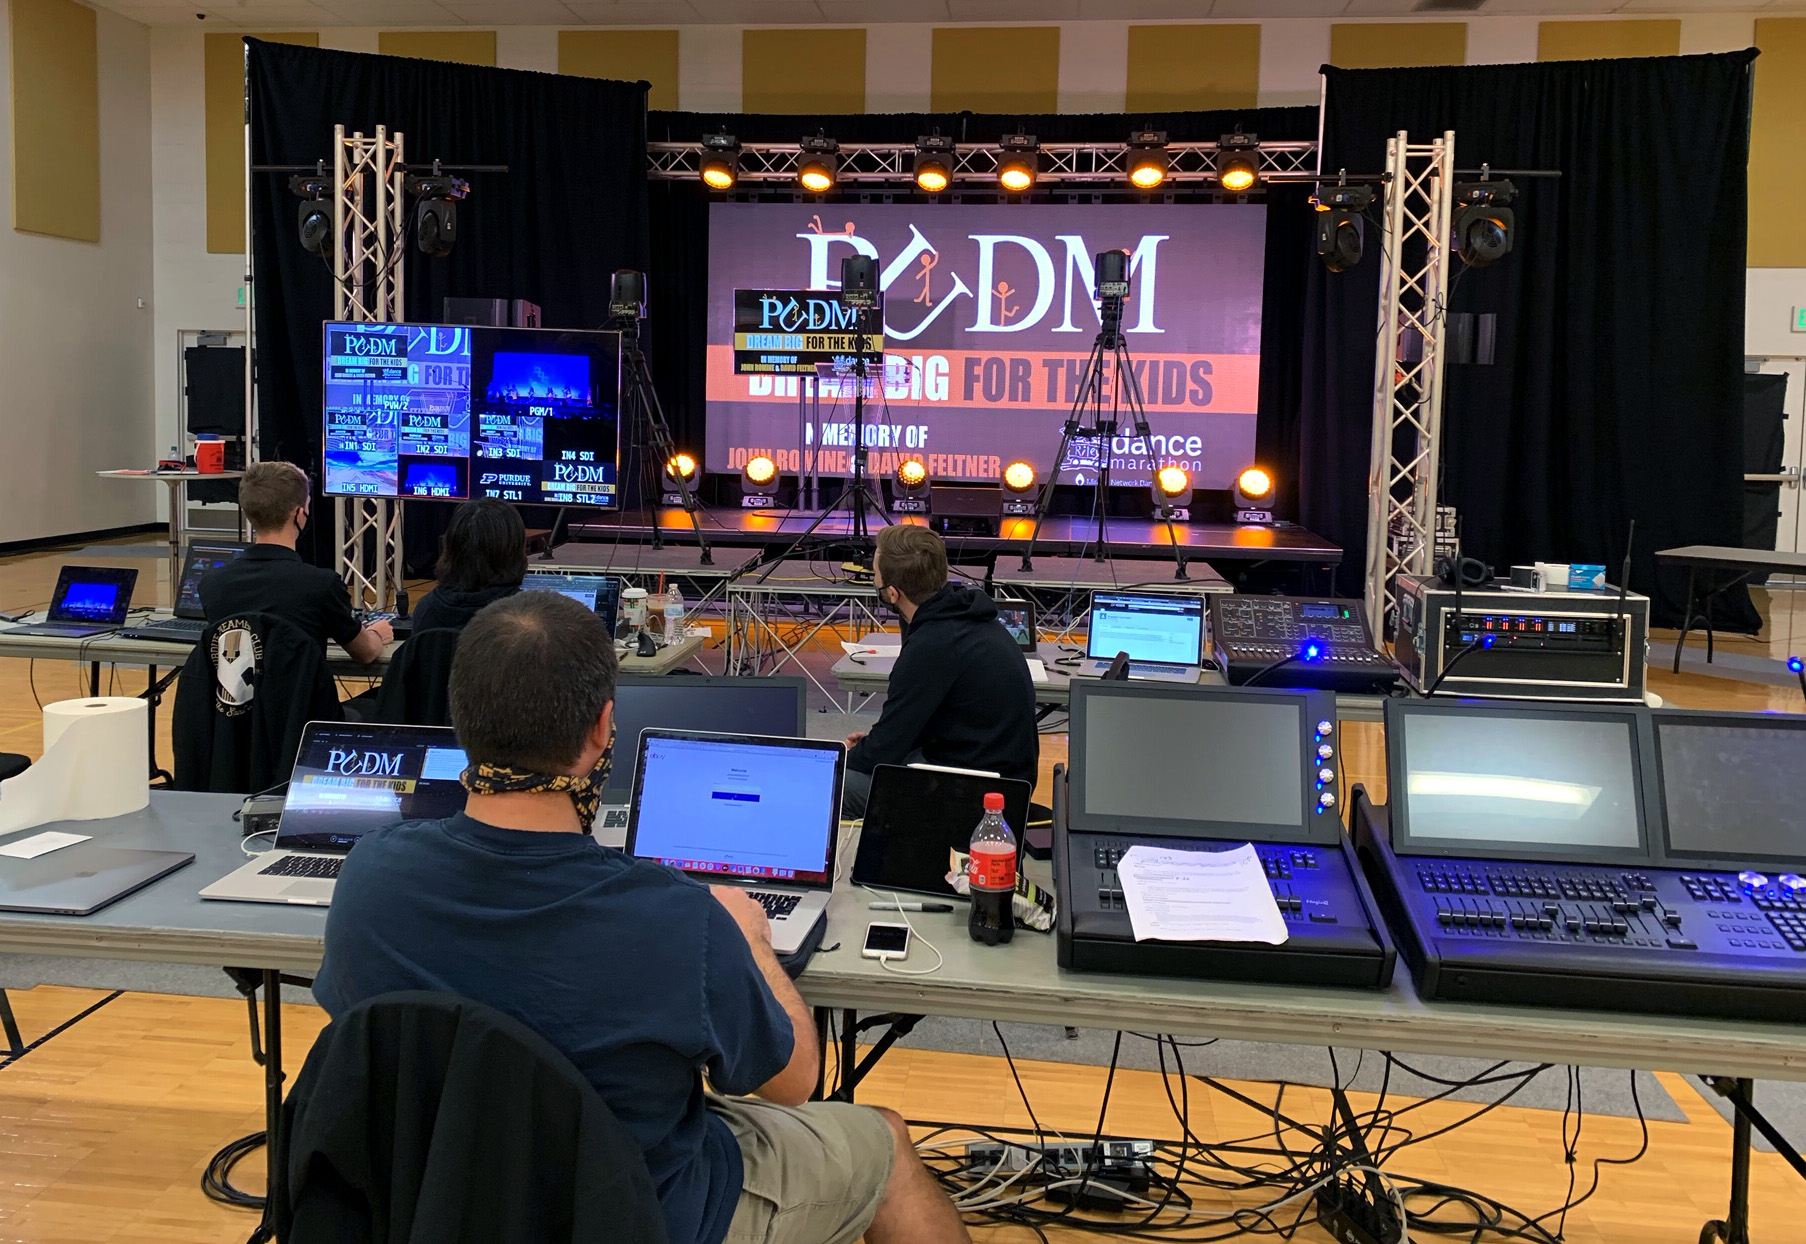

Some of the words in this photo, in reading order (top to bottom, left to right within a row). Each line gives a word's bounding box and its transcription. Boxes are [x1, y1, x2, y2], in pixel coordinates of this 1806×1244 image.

[746, 334, 782, 350] DREAM
[784, 335, 803, 350] BIG
[806, 336, 825, 350] FOR
[827, 336, 847, 350] THE
[369, 358, 380, 366] FOR
[424, 364, 453, 386] FOR
[885, 355, 950, 402] BIG
[963, 356, 1032, 403] FOR
[1042, 358, 1110, 404] THE
[1121, 359, 1213, 407] KIDS
[353, 394, 362, 405] IN
[529, 407, 553, 417] PGM/1
[905, 425, 929, 449] OF
[1111, 428, 1202, 457] dance
[345, 441, 358, 450] IN1
[362, 442, 376, 451] SDI
[416, 444, 430, 453] IN2
[434, 445, 448, 454] SDI
[488, 447, 503, 457] IN3
[506, 448, 521, 458] SDI
[561, 450, 576, 460] IN4
[580, 451, 595, 461] SDI
[929, 453, 1000, 479] FELTNER
[498, 473, 531, 483] PURDUE
[1110, 479, 1138, 487] Network
[342, 483, 356, 492] IN5
[359, 484, 378, 493] HDMI
[413, 486, 428, 496] IN6
[431, 488, 450, 497] HDMI
[503, 490, 522, 500] STL1
[559, 493, 573, 503] IN8
[576, 494, 596, 504] STL2
[324, 749, 404, 776] PUDM
[356, 778, 373, 790] FOR
[373, 779, 388, 790] THE
[388, 780, 407, 792] KIDS
